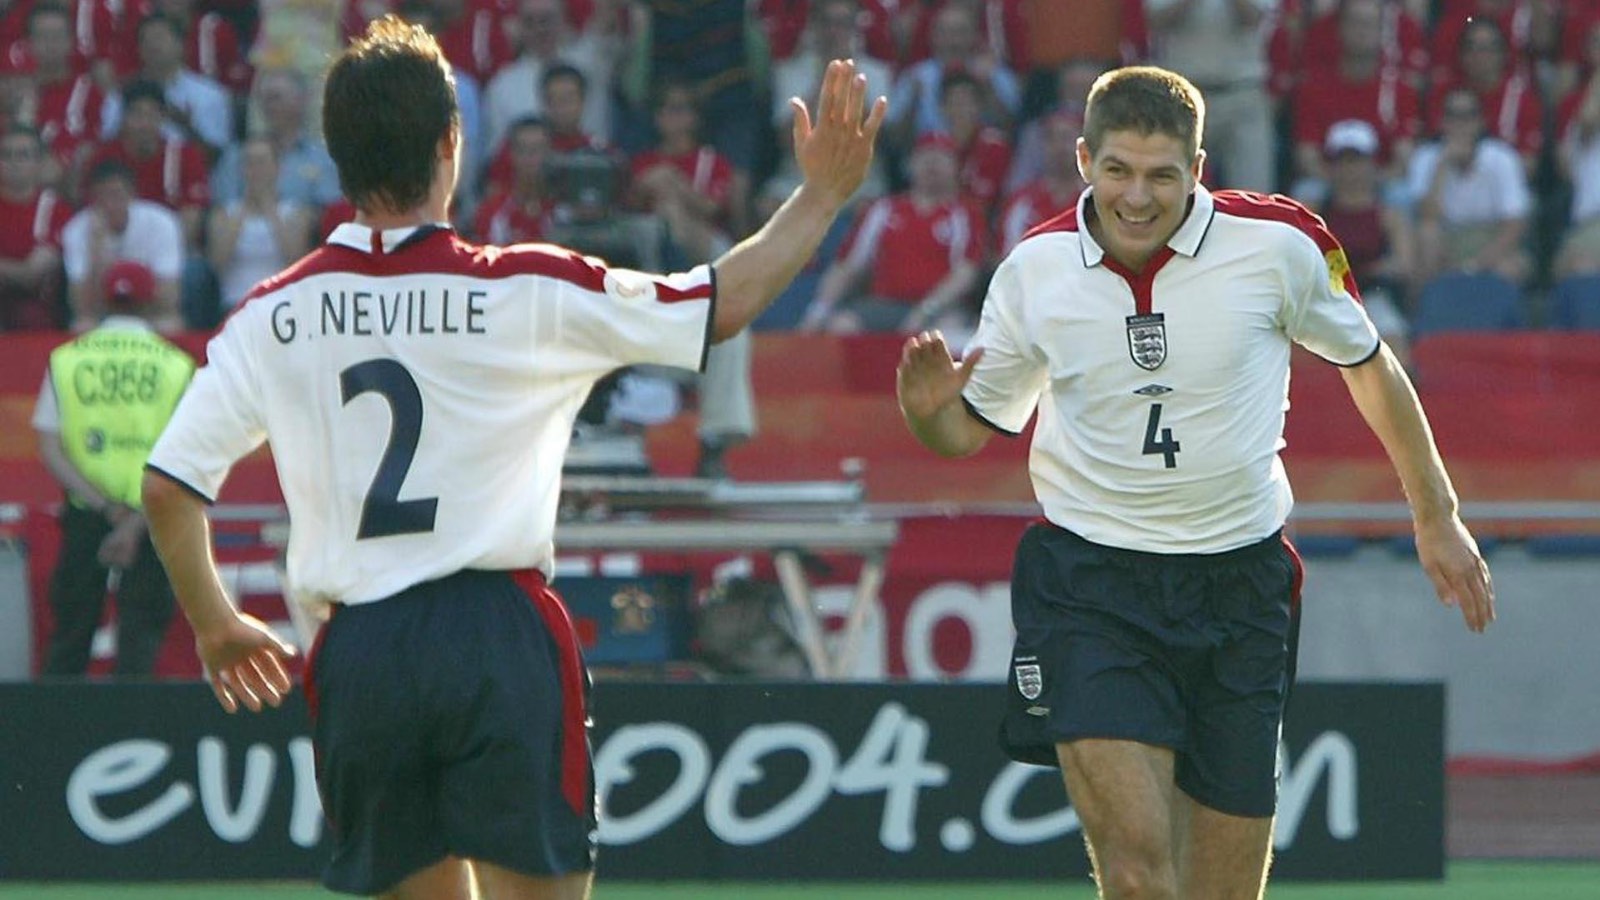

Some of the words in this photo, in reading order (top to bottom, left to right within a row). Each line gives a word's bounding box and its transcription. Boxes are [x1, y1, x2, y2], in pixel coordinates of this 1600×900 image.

[320, 289, 487, 336] NEVILLE
[339, 357, 439, 541] 2
[1142, 403, 1180, 469] 4
